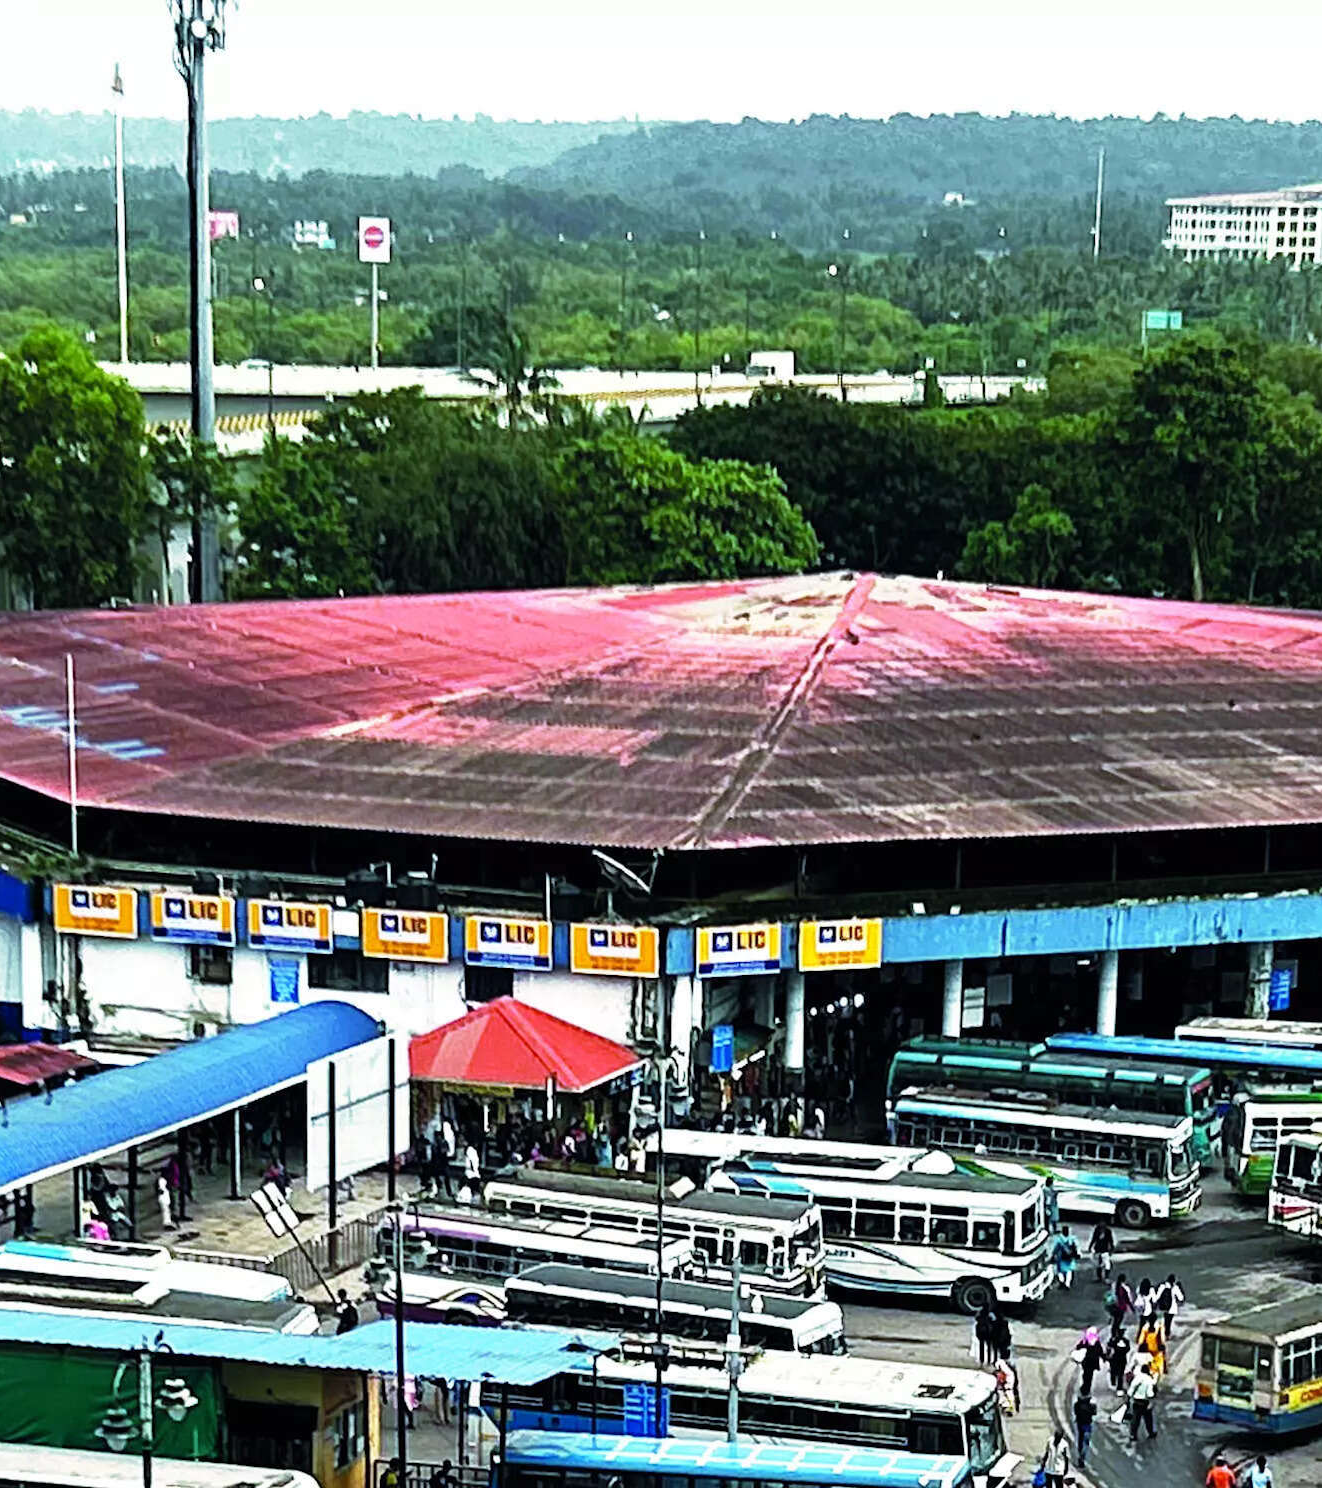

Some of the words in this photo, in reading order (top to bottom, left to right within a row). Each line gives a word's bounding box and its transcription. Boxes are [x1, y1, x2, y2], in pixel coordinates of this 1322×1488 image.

[189, 900, 219, 920] LIC
[285, 908, 316, 928] LIC
[401, 916, 428, 933] LIC
[506, 924, 535, 944] LIC
[839, 926, 863, 941] LIC
[611, 931, 637, 948] LIC
[737, 931, 765, 950] LIC
